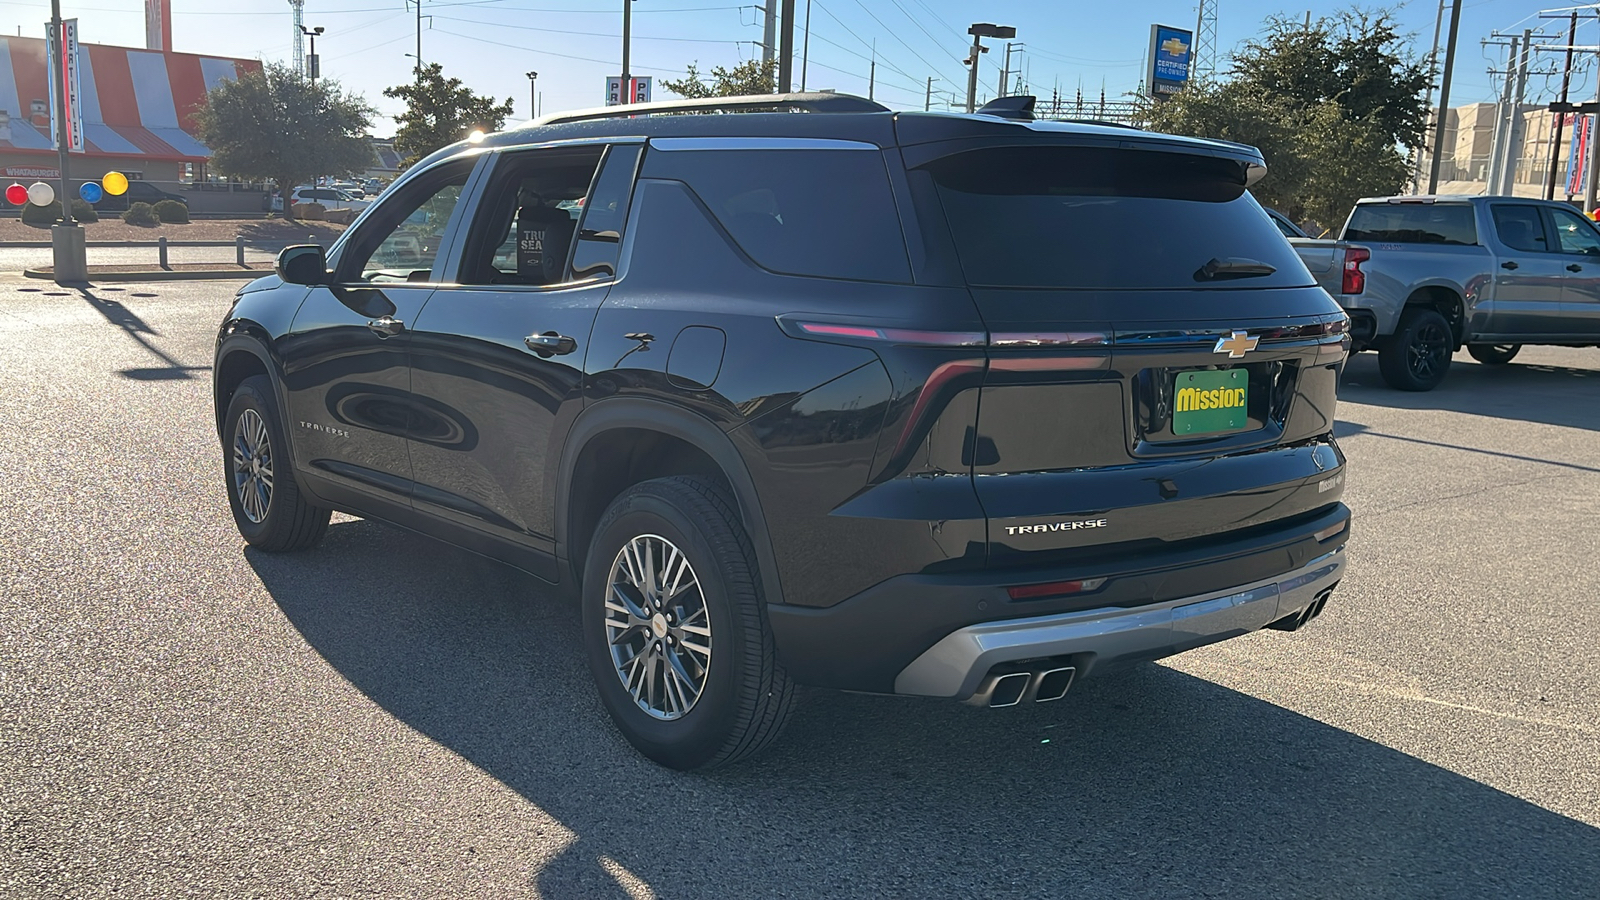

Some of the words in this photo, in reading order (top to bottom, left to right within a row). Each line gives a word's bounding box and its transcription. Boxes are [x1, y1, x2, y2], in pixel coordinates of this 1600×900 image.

[1157, 59, 1187, 70] CERTIFIED
[1158, 67, 1185, 76] PRE-OWNED
[67, 25, 79, 146] CERTIFIED
[6, 167, 60, 177] WHATABURGER
[1176, 386, 1245, 412] Mission
[300, 421, 350, 439] TRAVERSE
[1004, 518, 1107, 535] TRAVERSE
